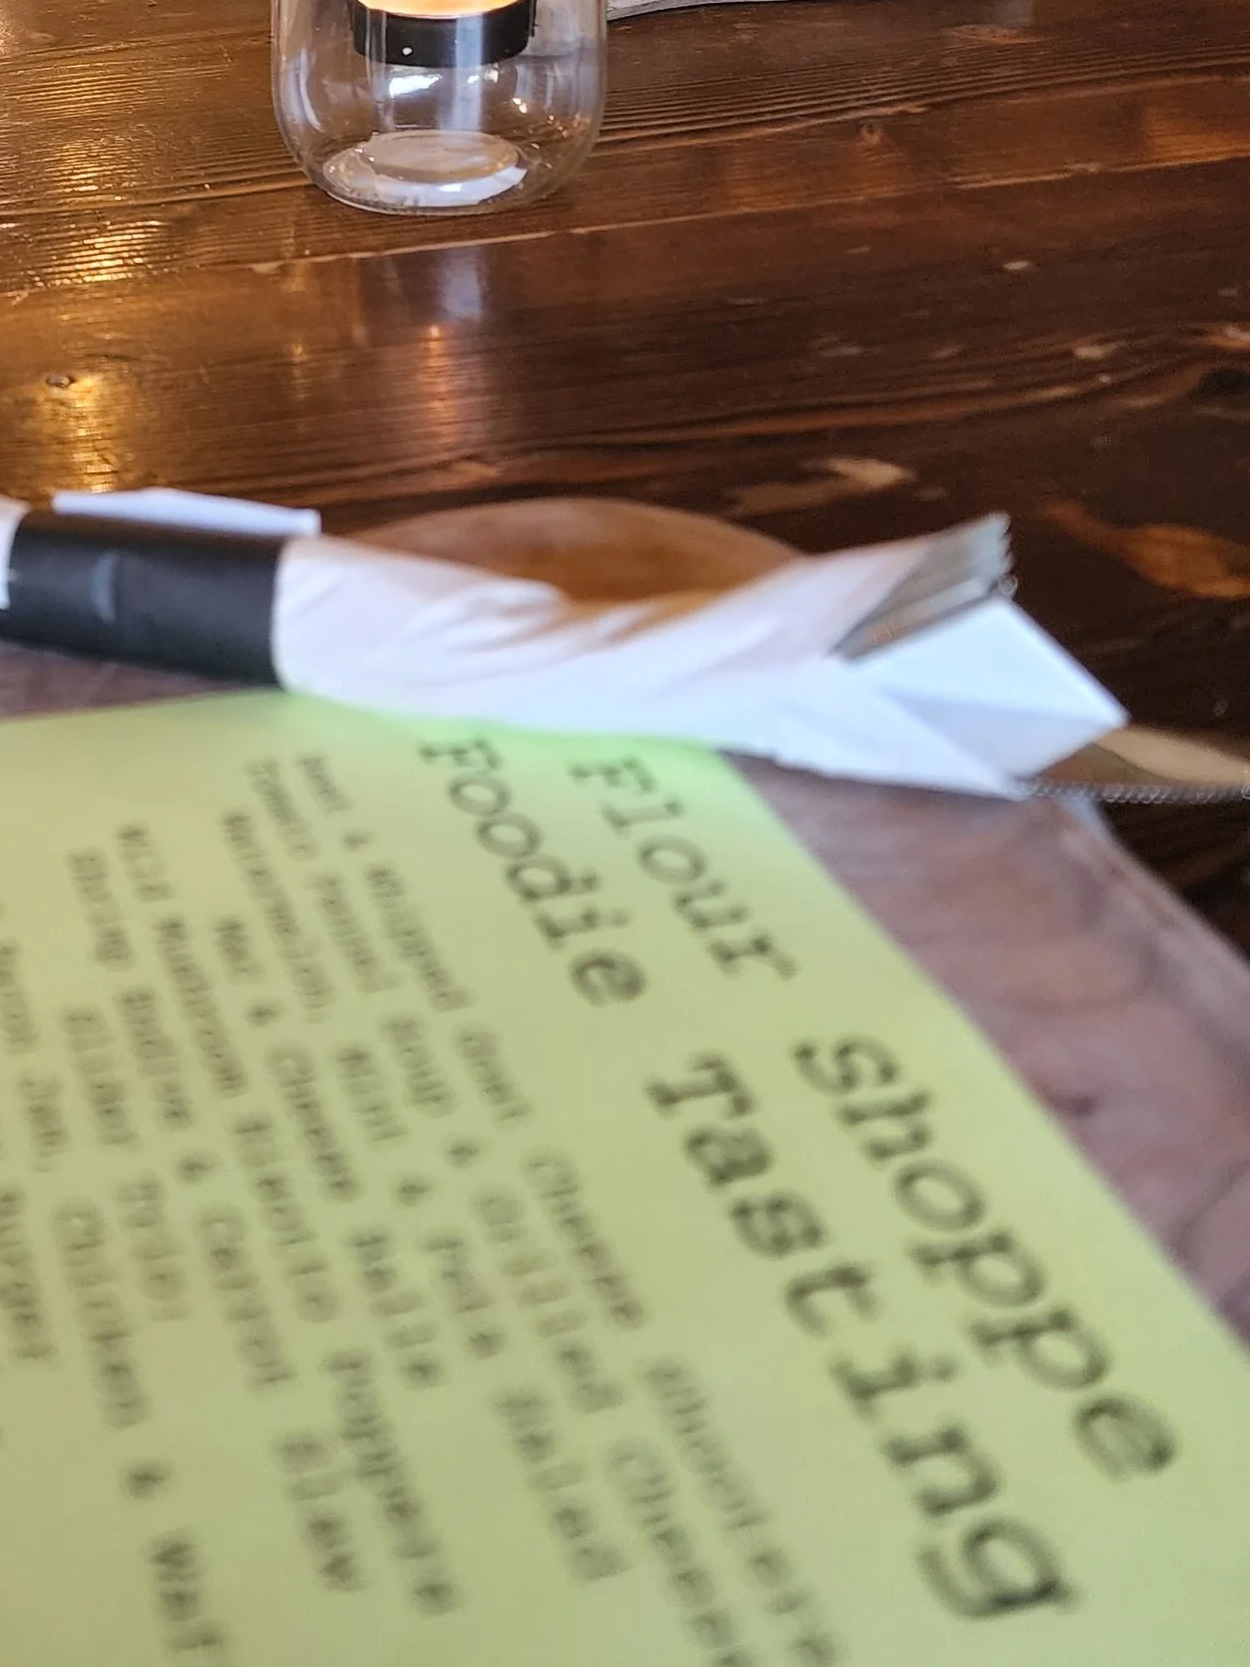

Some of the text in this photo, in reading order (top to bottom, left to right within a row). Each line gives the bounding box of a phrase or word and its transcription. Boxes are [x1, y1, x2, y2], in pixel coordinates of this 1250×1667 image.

[156, 917, 249, 1099] Mushroom
[323, 1350, 462, 1617] Poppers
[263, 1044, 365, 1202] Cheese
[343, 1228, 447, 1388] Balls
[363, 864, 476, 1013] Whipped
[521, 1152, 649, 1332] Cheese
[419, 739, 1079, 1622] Foodie Tasting
[565, 755, 1181, 1481] Flour Shoppe
[51, 1204, 150, 1430] Chicken
[197, 1208, 283, 1394] Carrot
[269, 1434, 368, 1594] Slaw
[472, 1185, 627, 1414] Grilled
[495, 1388, 632, 1581] Salad
